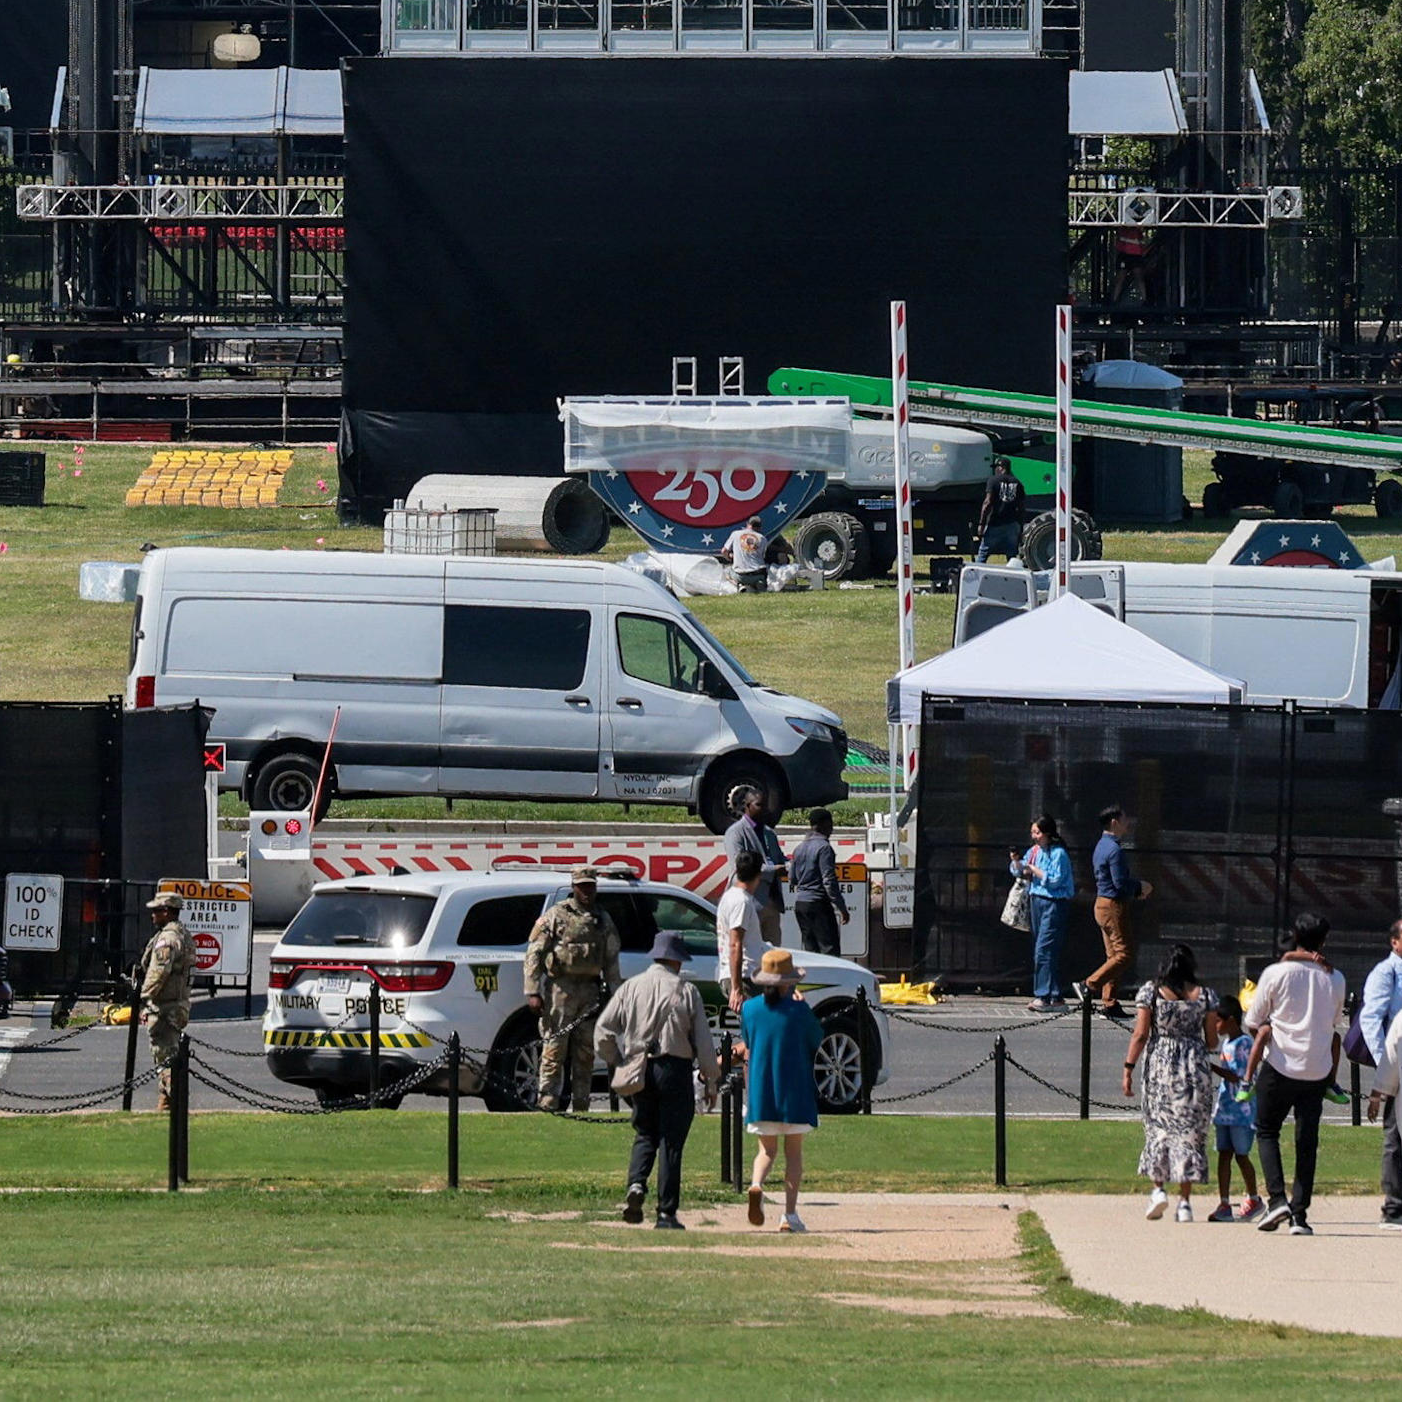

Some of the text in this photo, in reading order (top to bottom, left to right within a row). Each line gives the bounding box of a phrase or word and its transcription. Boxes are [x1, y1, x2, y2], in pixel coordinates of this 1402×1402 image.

[653, 457, 766, 518] 250
[491, 854, 701, 882] OP
[175, 883, 235, 898] NOTICE
[25, 908, 40, 920] ID
[181, 901, 237, 912] ESTRICTED
[890, 906, 912, 914] SIDEWAL
[190, 912, 218, 922] AREA
[9, 923, 54, 938] CHECK
[475, 976, 498, 991] 911
[275, 995, 405, 1015] MILITARY POCE
